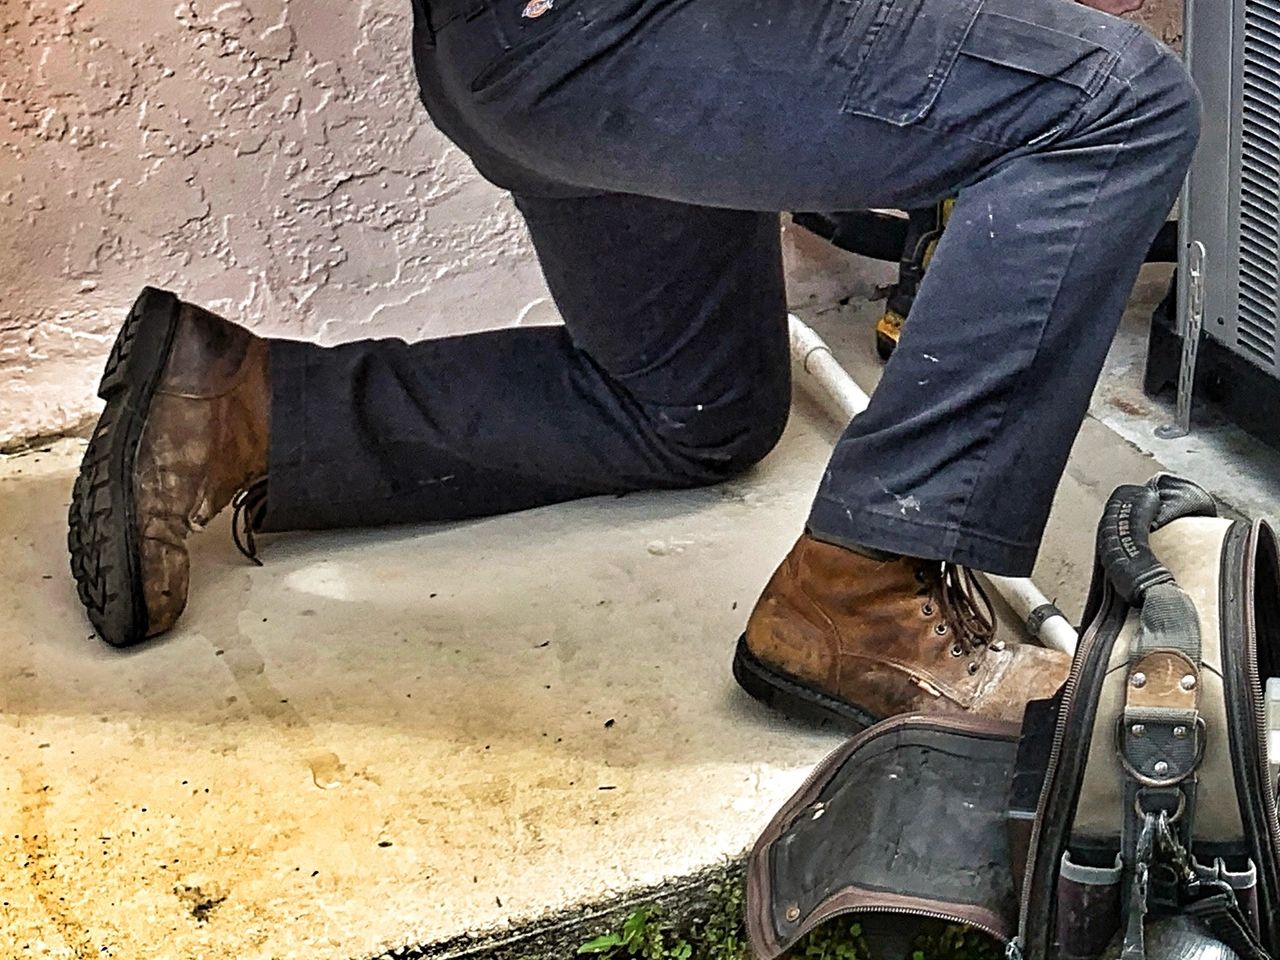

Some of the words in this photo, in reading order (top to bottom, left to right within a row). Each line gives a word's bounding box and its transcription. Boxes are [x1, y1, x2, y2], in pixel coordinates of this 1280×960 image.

[1119, 503, 1132, 518] PAC
[1119, 520, 1130, 536] PRO
[1121, 537, 1139, 557] VETO
